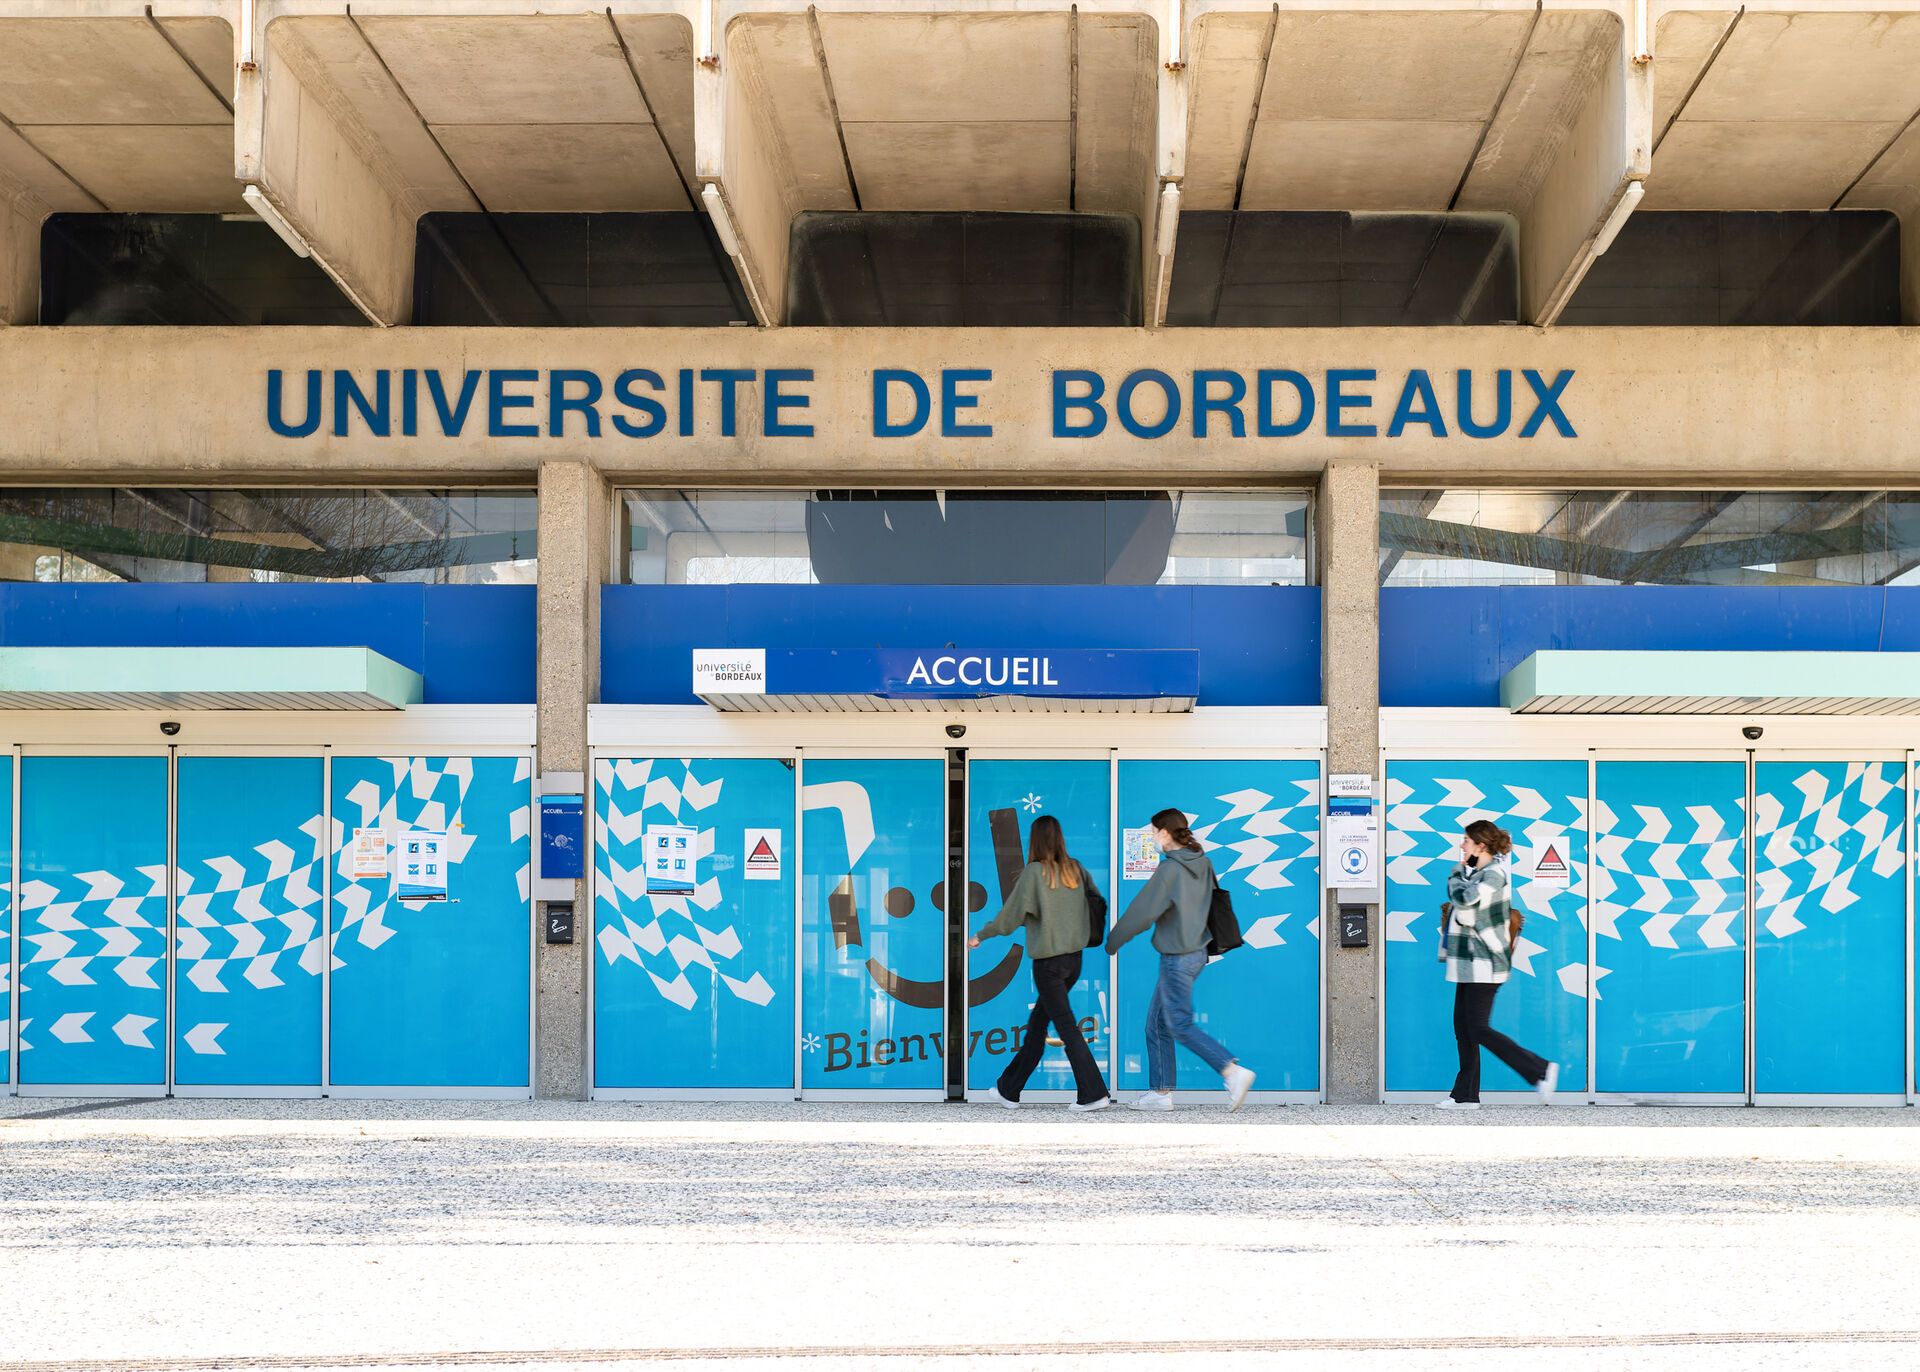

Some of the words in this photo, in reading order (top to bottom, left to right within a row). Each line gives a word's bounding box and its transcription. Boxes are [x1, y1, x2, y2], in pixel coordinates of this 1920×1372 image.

[267, 369, 814, 438] UNIVERSITE
[873, 369, 993, 438] DE
[1053, 369, 1577, 438] BORDEAUX
[696, 660, 752, 672] université
[715, 672, 762, 681] BORDEAUX
[906, 656, 1058, 686] ACCUEIL
